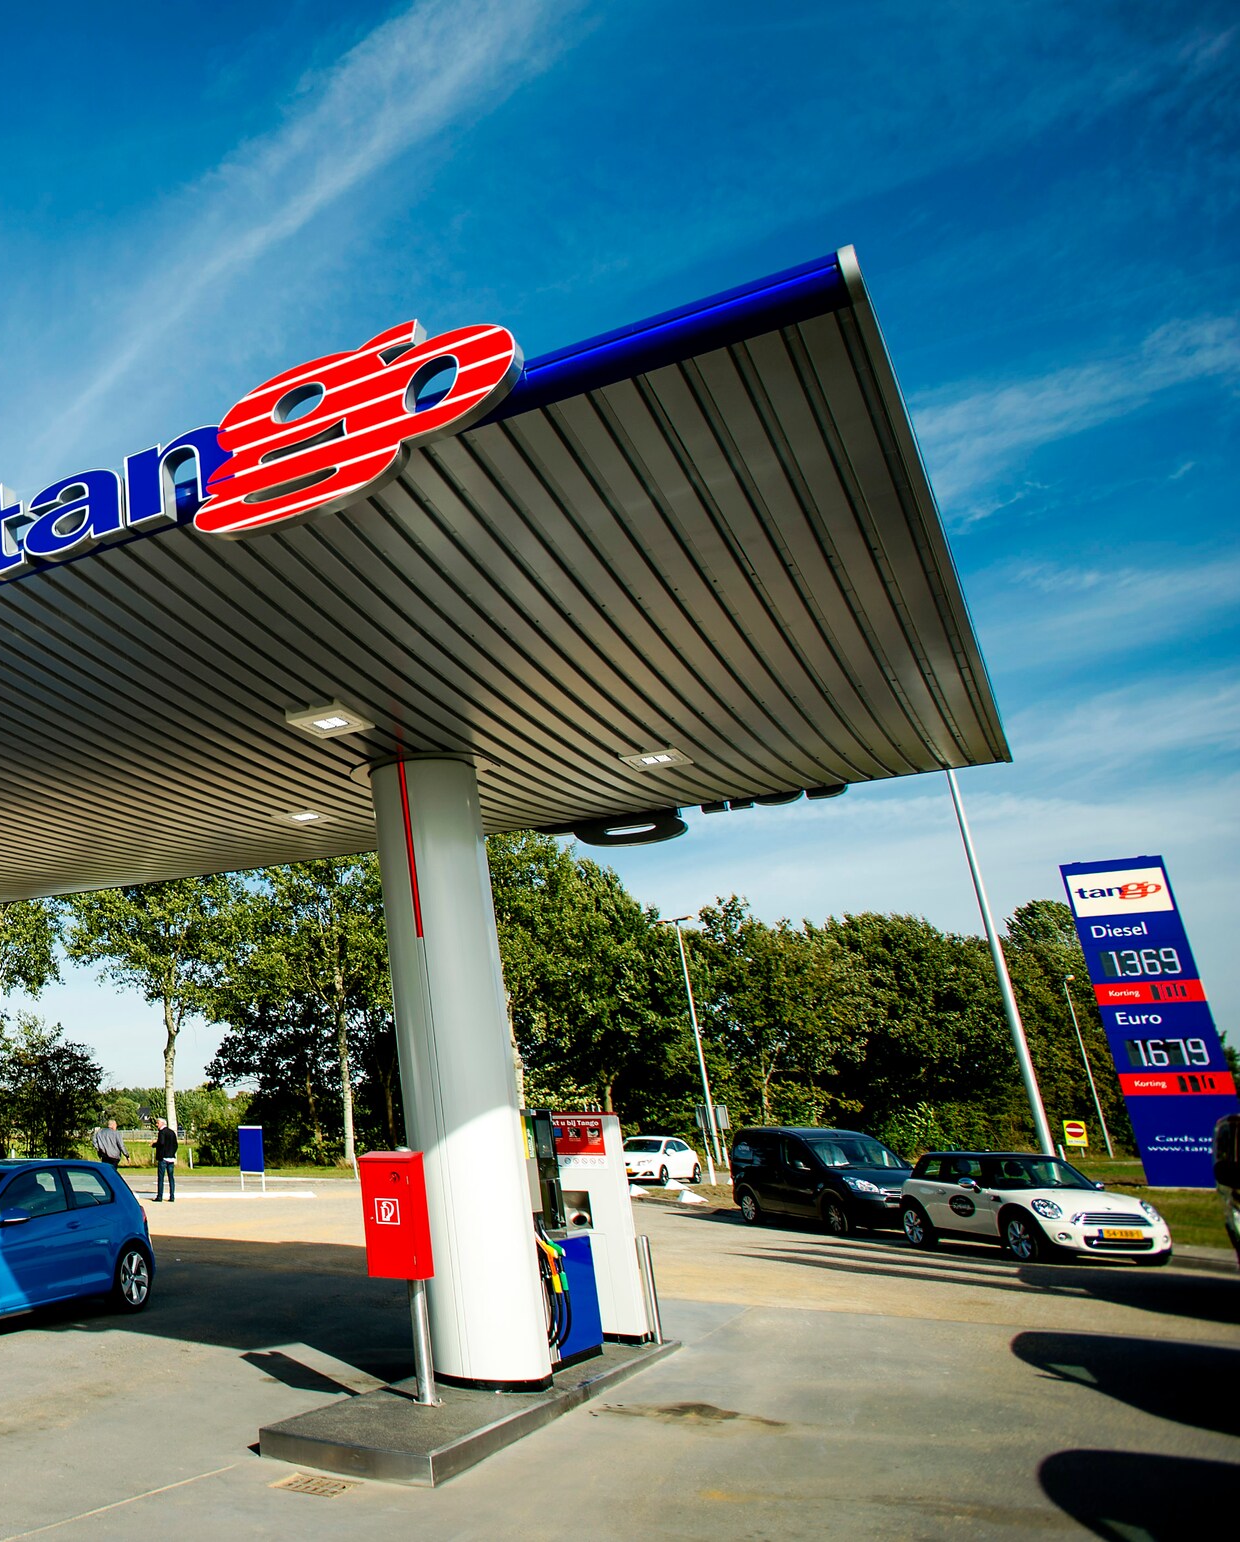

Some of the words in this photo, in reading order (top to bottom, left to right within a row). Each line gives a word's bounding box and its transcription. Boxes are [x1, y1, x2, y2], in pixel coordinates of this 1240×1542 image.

[1074, 881, 1162, 900] tango
[1090, 921, 1149, 938] Diesel
[1108, 947, 1182, 977] 1.369
[1108, 989, 1141, 998] Korting
[1115, 1011, 1163, 1026] Euro
[1133, 1038, 1211, 1067] 1.679
[1133, 1080, 1167, 1089] Korting
[1155, 1135, 1195, 1143] Cards
